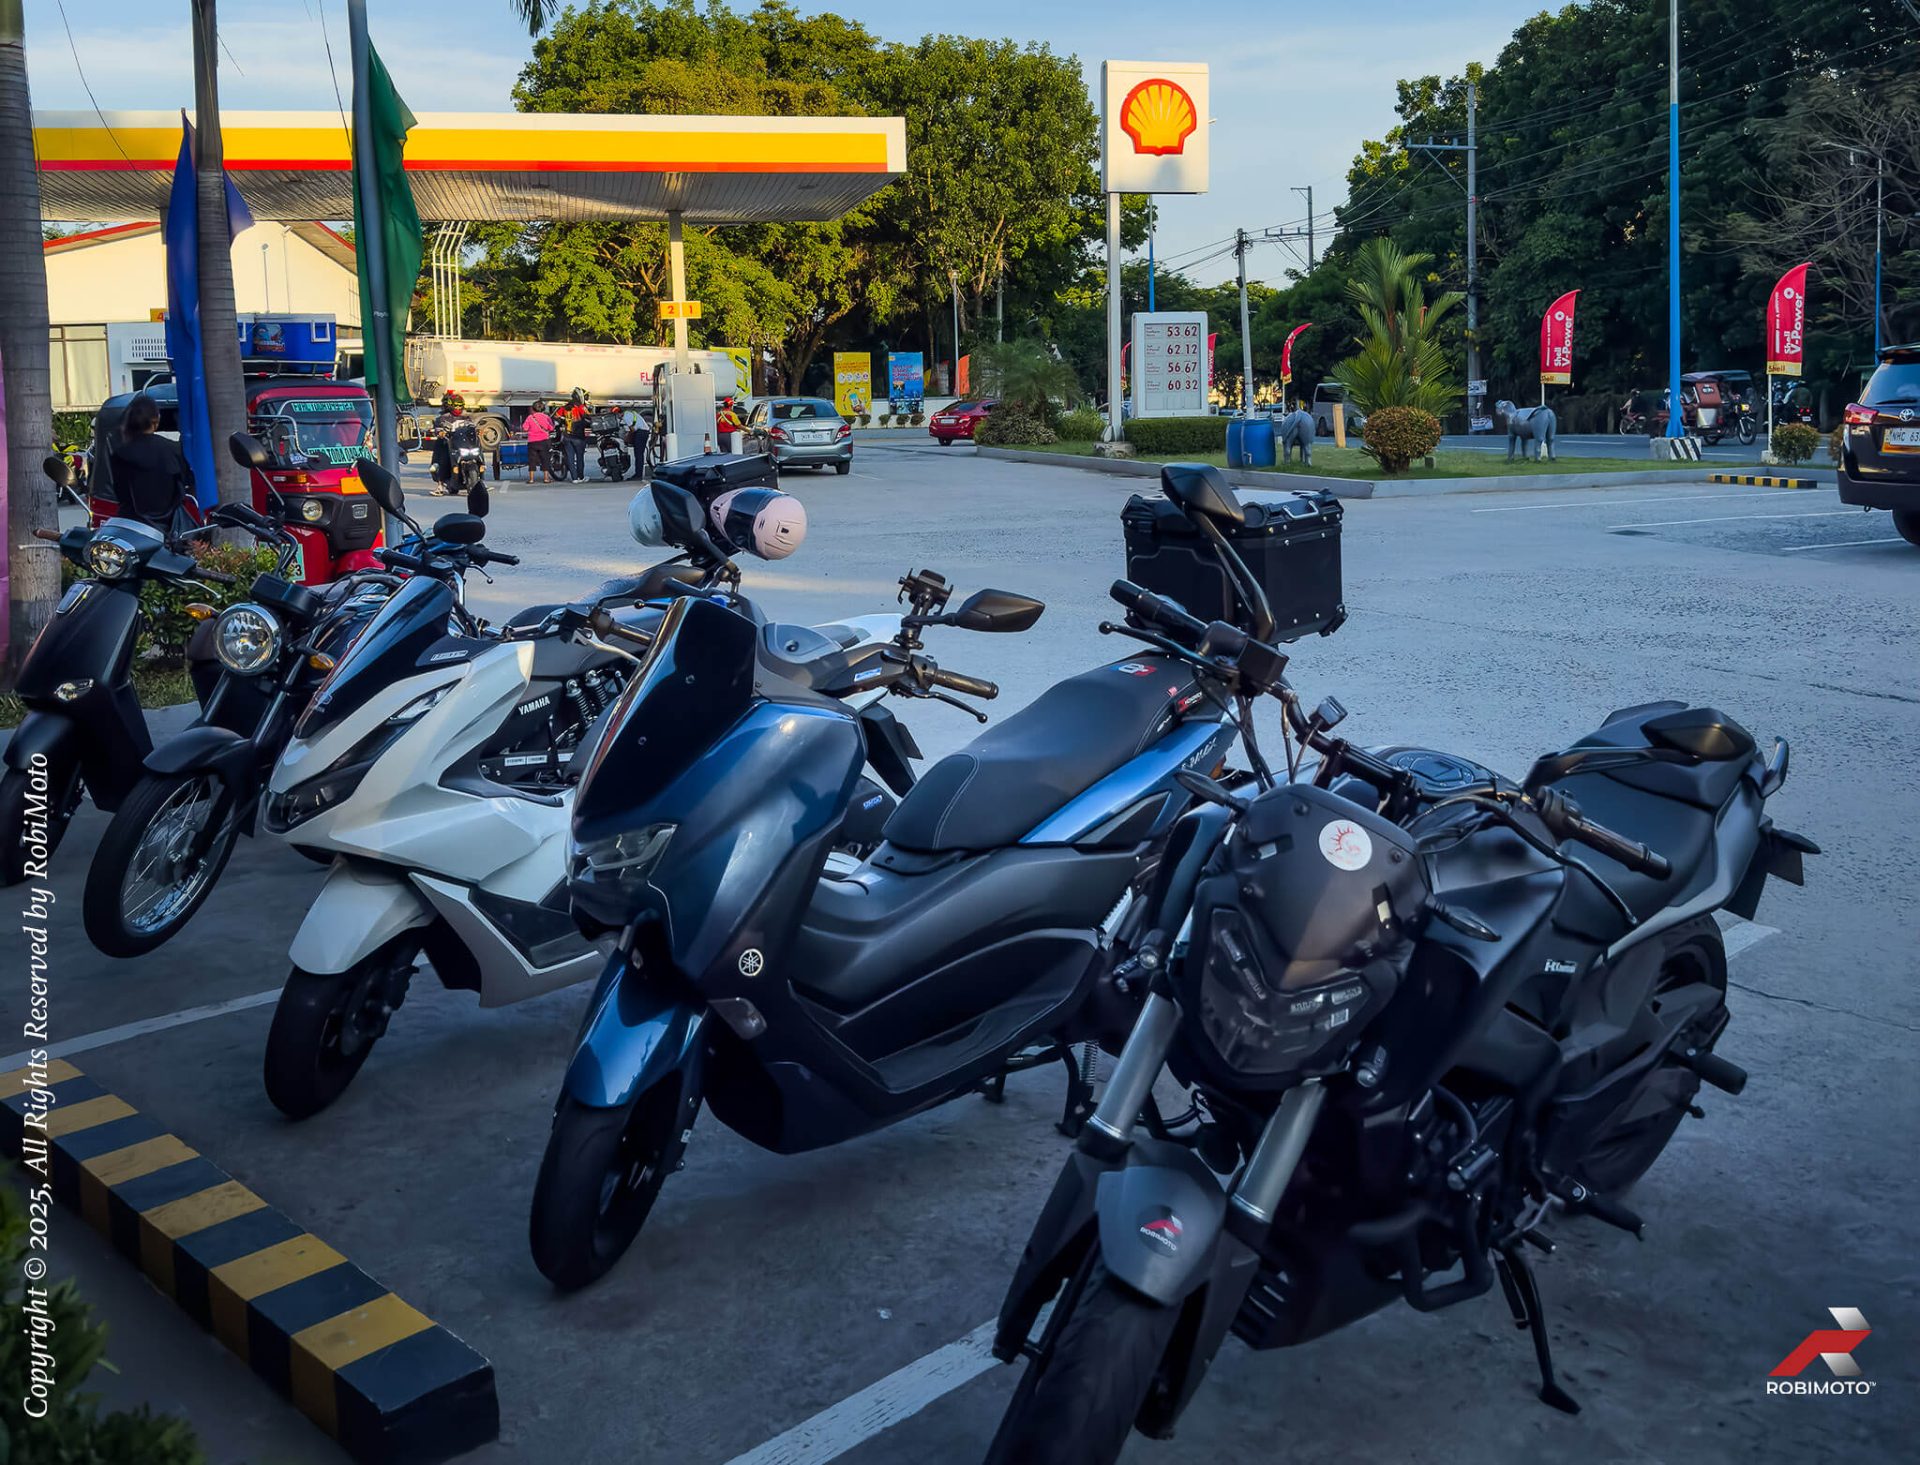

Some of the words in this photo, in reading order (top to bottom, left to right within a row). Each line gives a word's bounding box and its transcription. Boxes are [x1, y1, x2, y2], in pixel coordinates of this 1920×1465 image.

[667, 305, 675, 314] 2
[689, 305, 693, 314] 1
[1790, 293, 1804, 355] V-Power
[1563, 316, 1573, 367] V-Power
[640, 371, 655, 381] FL
[1892, 431, 1907, 442] NHC
[1909, 431, 1920, 442] 63
[518, 696, 551, 715] YAMAHA
